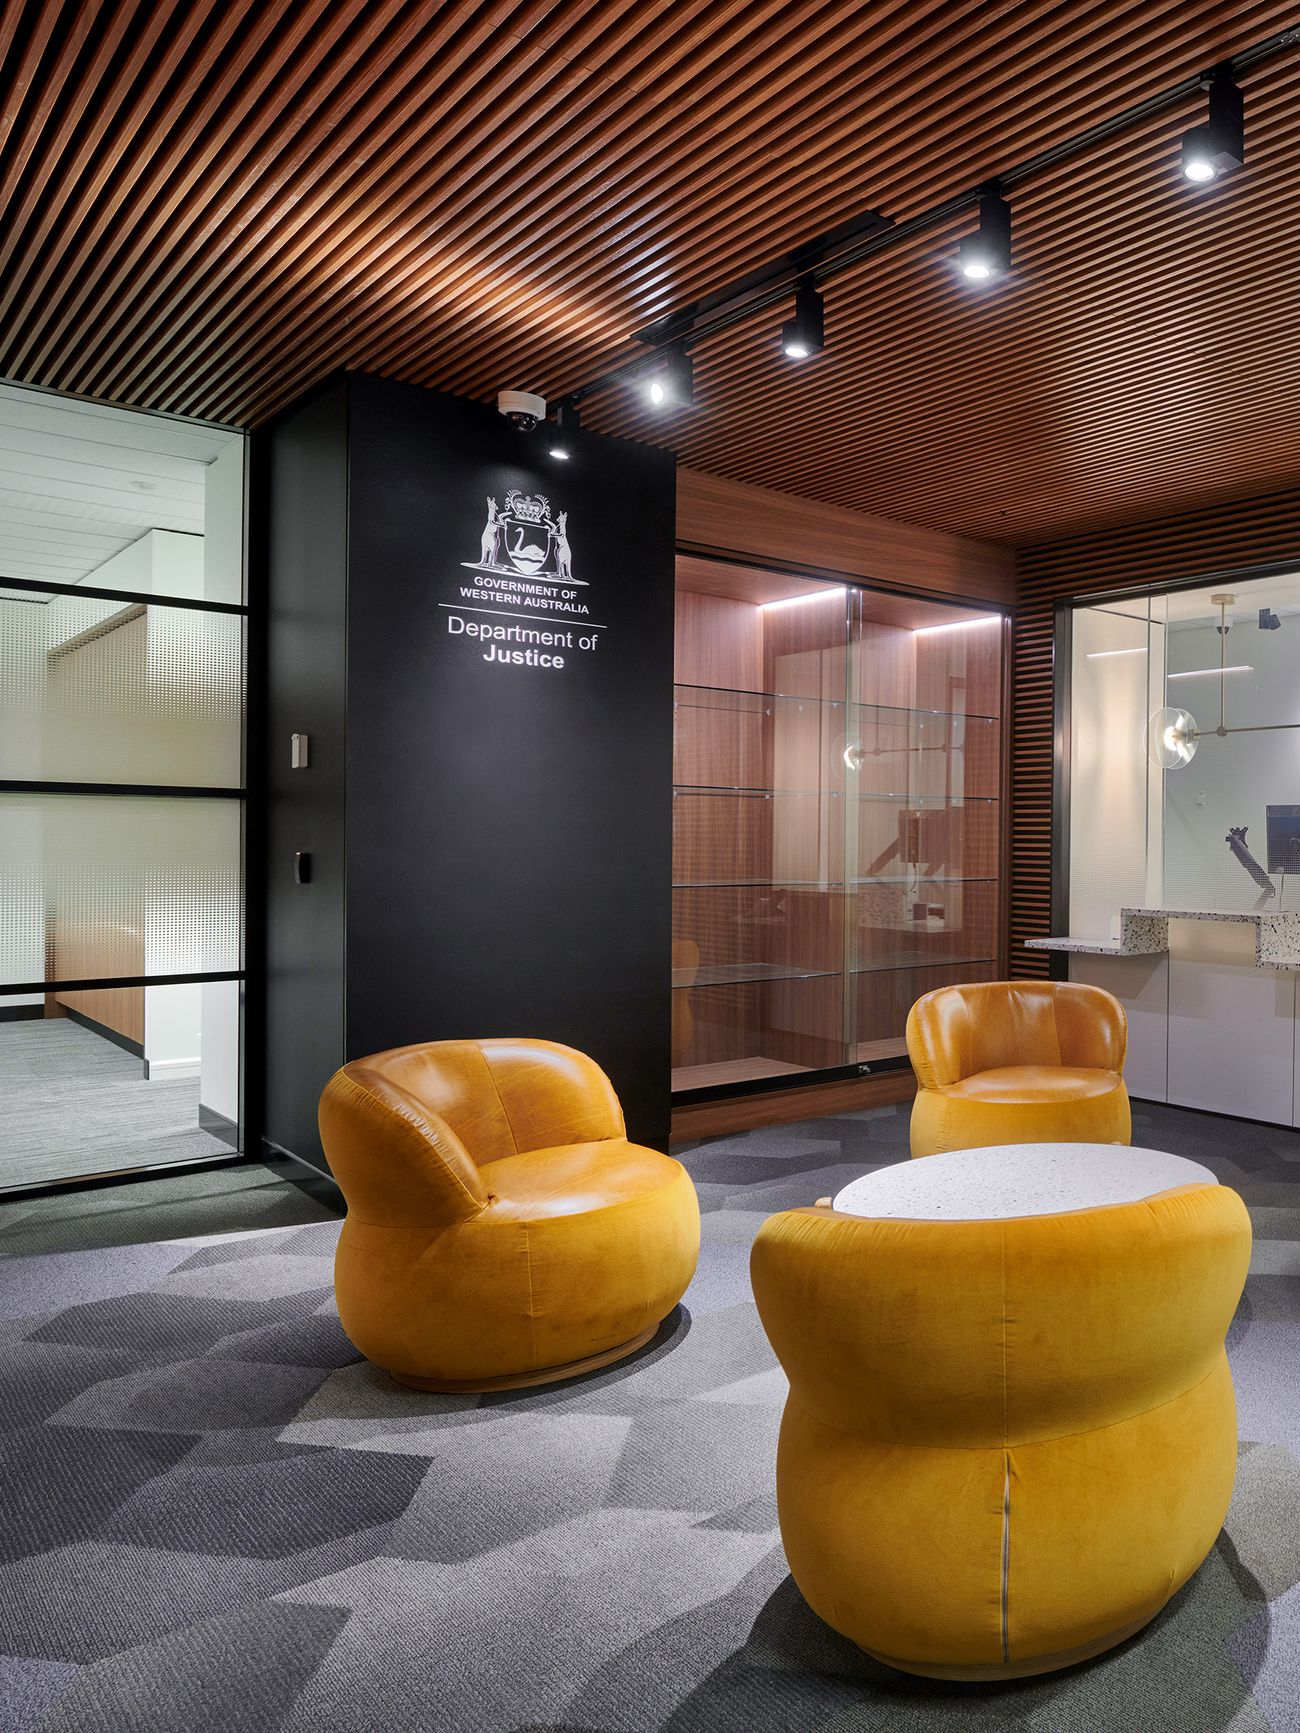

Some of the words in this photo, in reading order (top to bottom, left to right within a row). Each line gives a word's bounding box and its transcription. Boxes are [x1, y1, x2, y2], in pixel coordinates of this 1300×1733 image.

[460, 587, 521, 604] WESTERN
[523, 596, 589, 614] AUSTRALIA
[474, 576, 558, 597] GOVERNMENT
[561, 589, 577, 600] OF
[448, 615, 573, 648] Department
[578, 634, 598, 650] of
[483, 644, 565, 669] Justice
